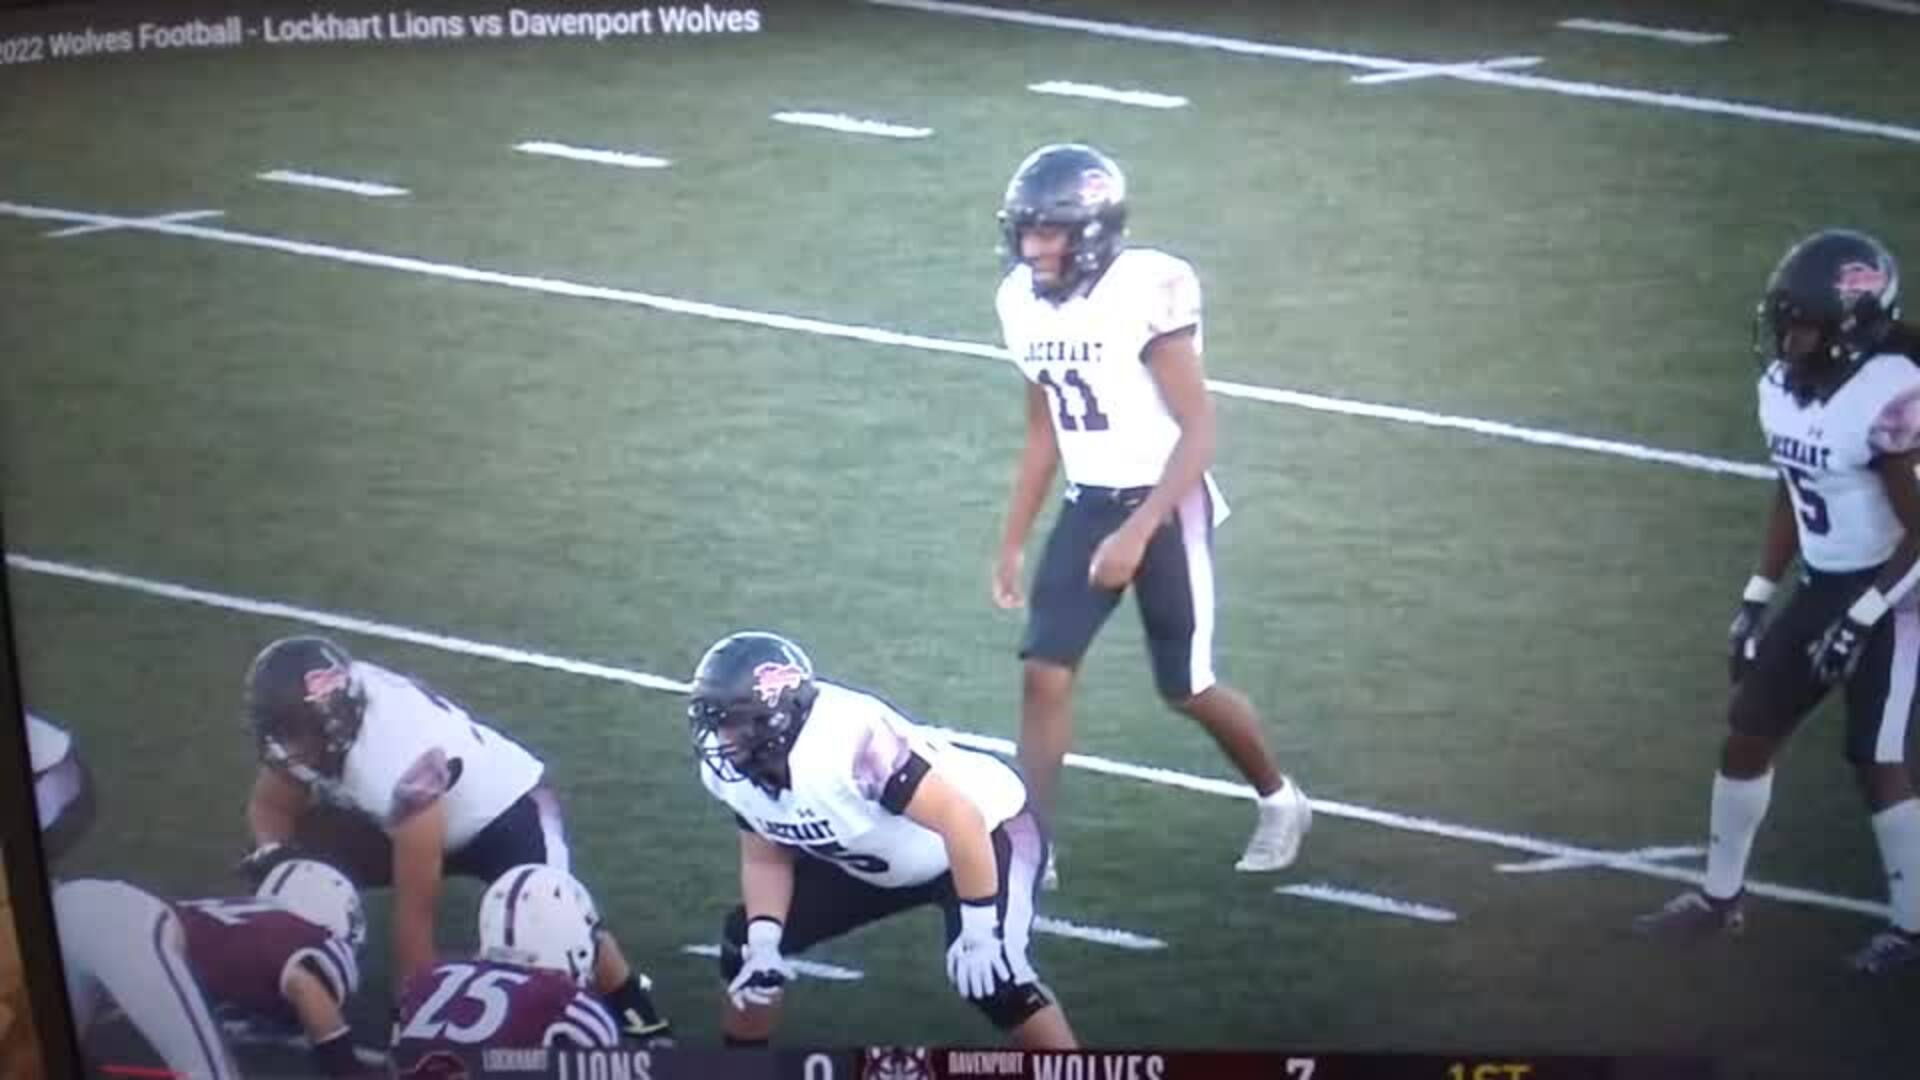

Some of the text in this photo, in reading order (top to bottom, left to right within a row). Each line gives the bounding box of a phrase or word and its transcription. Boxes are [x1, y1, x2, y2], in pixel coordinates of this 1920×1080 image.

[49, 29, 132, 57] Wolves
[138, 16, 242, 49] Football
[263, 13, 383, 42] Lockhart
[389, 10, 466, 39] Lions
[470, 18, 503, 37] vs
[509, 8, 653, 39] Davenport
[658, 4, 761, 34] Wolves
[1037, 368, 1110, 432] 11
[558, 1051, 652, 1080] LIONS
[1032, 1054, 1166, 1080] WOLVES
[1285, 1057, 1316, 1080] 7
